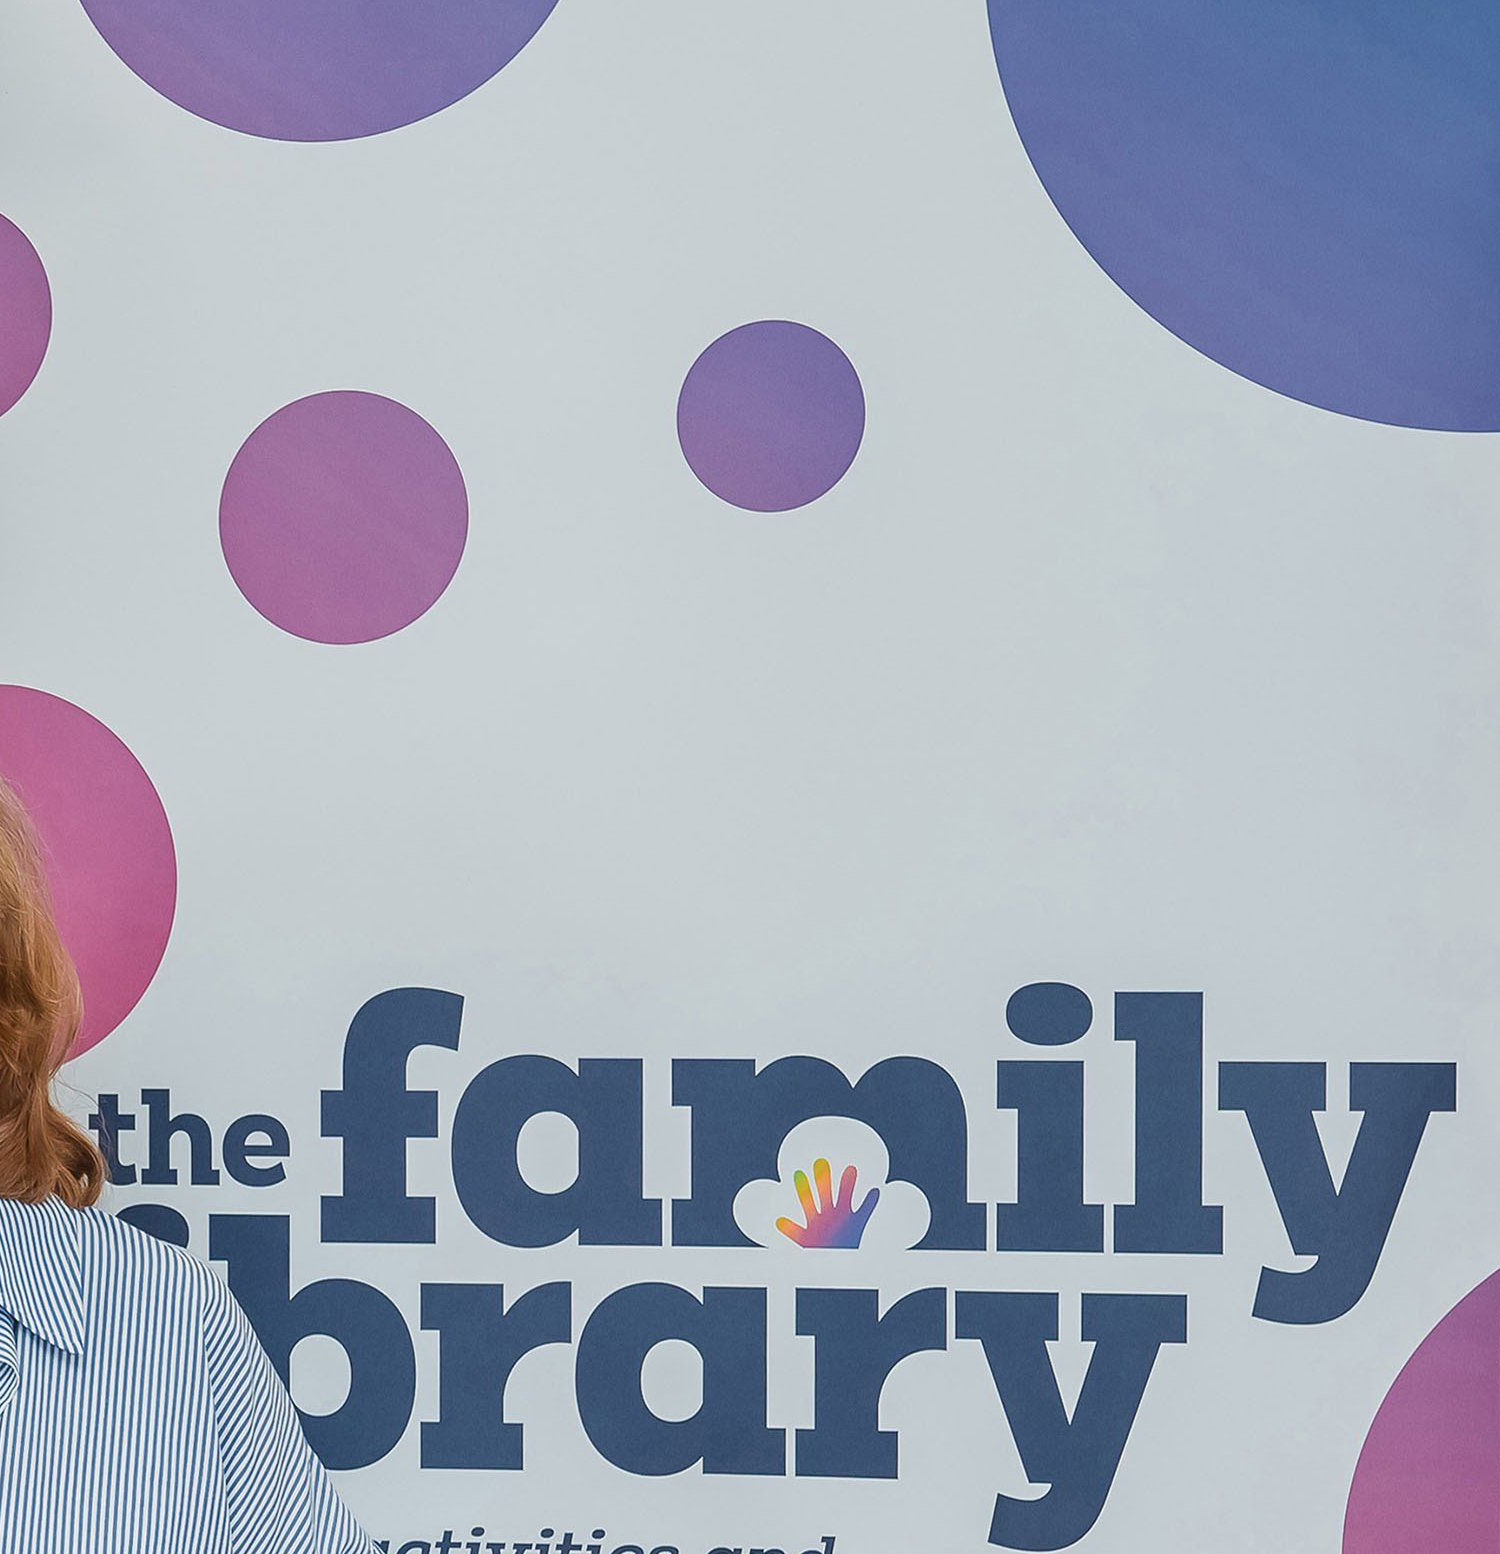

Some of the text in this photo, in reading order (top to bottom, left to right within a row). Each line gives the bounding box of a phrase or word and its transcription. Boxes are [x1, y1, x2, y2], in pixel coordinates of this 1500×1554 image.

[89, 981, 1457, 1327] the family
[112, 1204, 1187, 1552] brary
